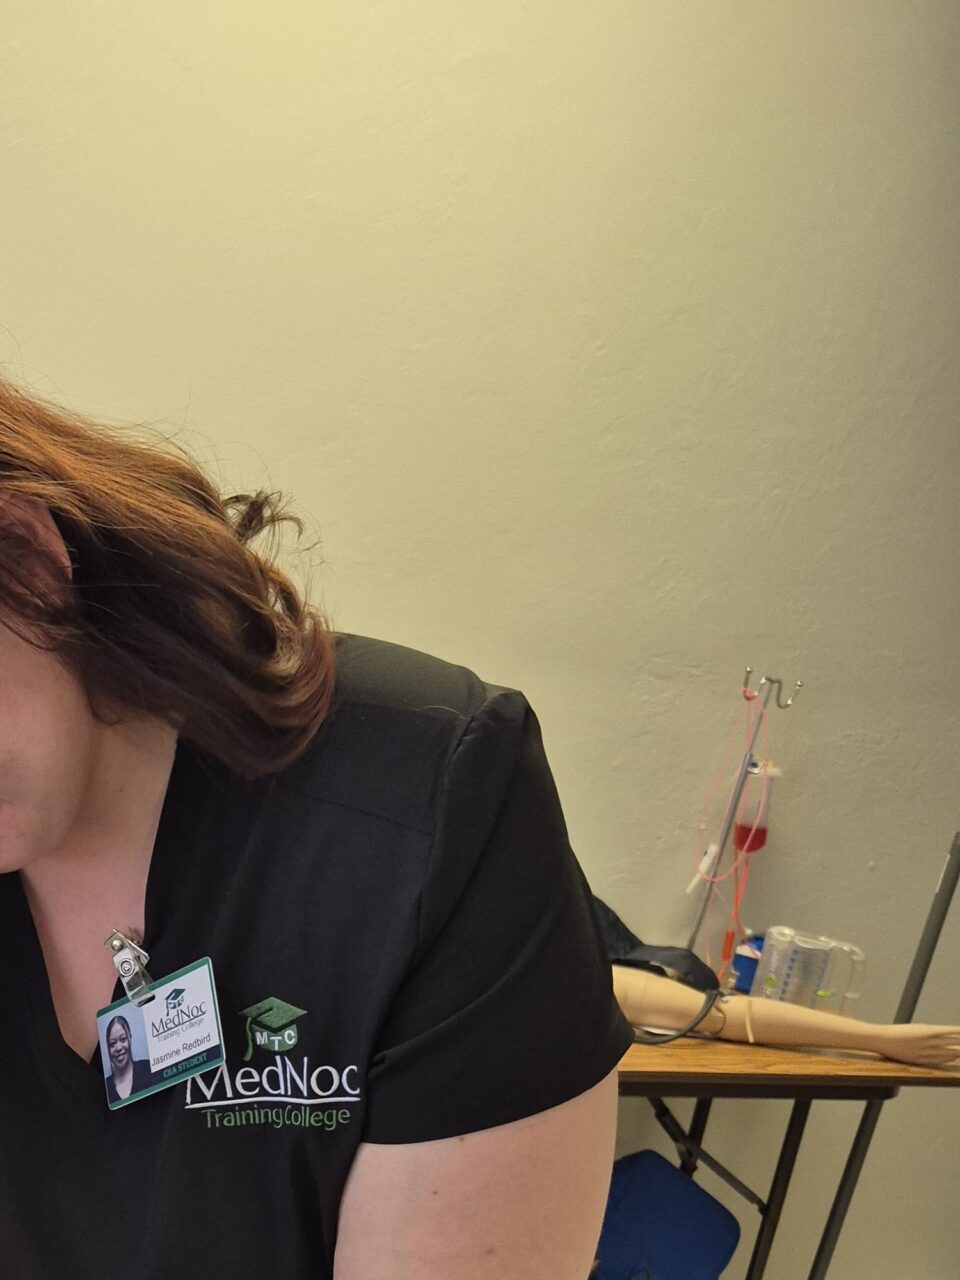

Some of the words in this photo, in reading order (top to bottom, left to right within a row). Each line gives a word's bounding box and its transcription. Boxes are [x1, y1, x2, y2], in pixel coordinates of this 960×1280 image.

[152, 1001, 206, 1038] MedNoc
[157, 1028, 181, 1042] Training
[181, 1018, 204, 1033] College
[152, 1048, 181, 1067] Jasmine
[182, 1032, 211, 1053] Redbird
[178, 1052, 208, 1072] STUDENT
[186, 1055, 361, 1104] MedNoc
